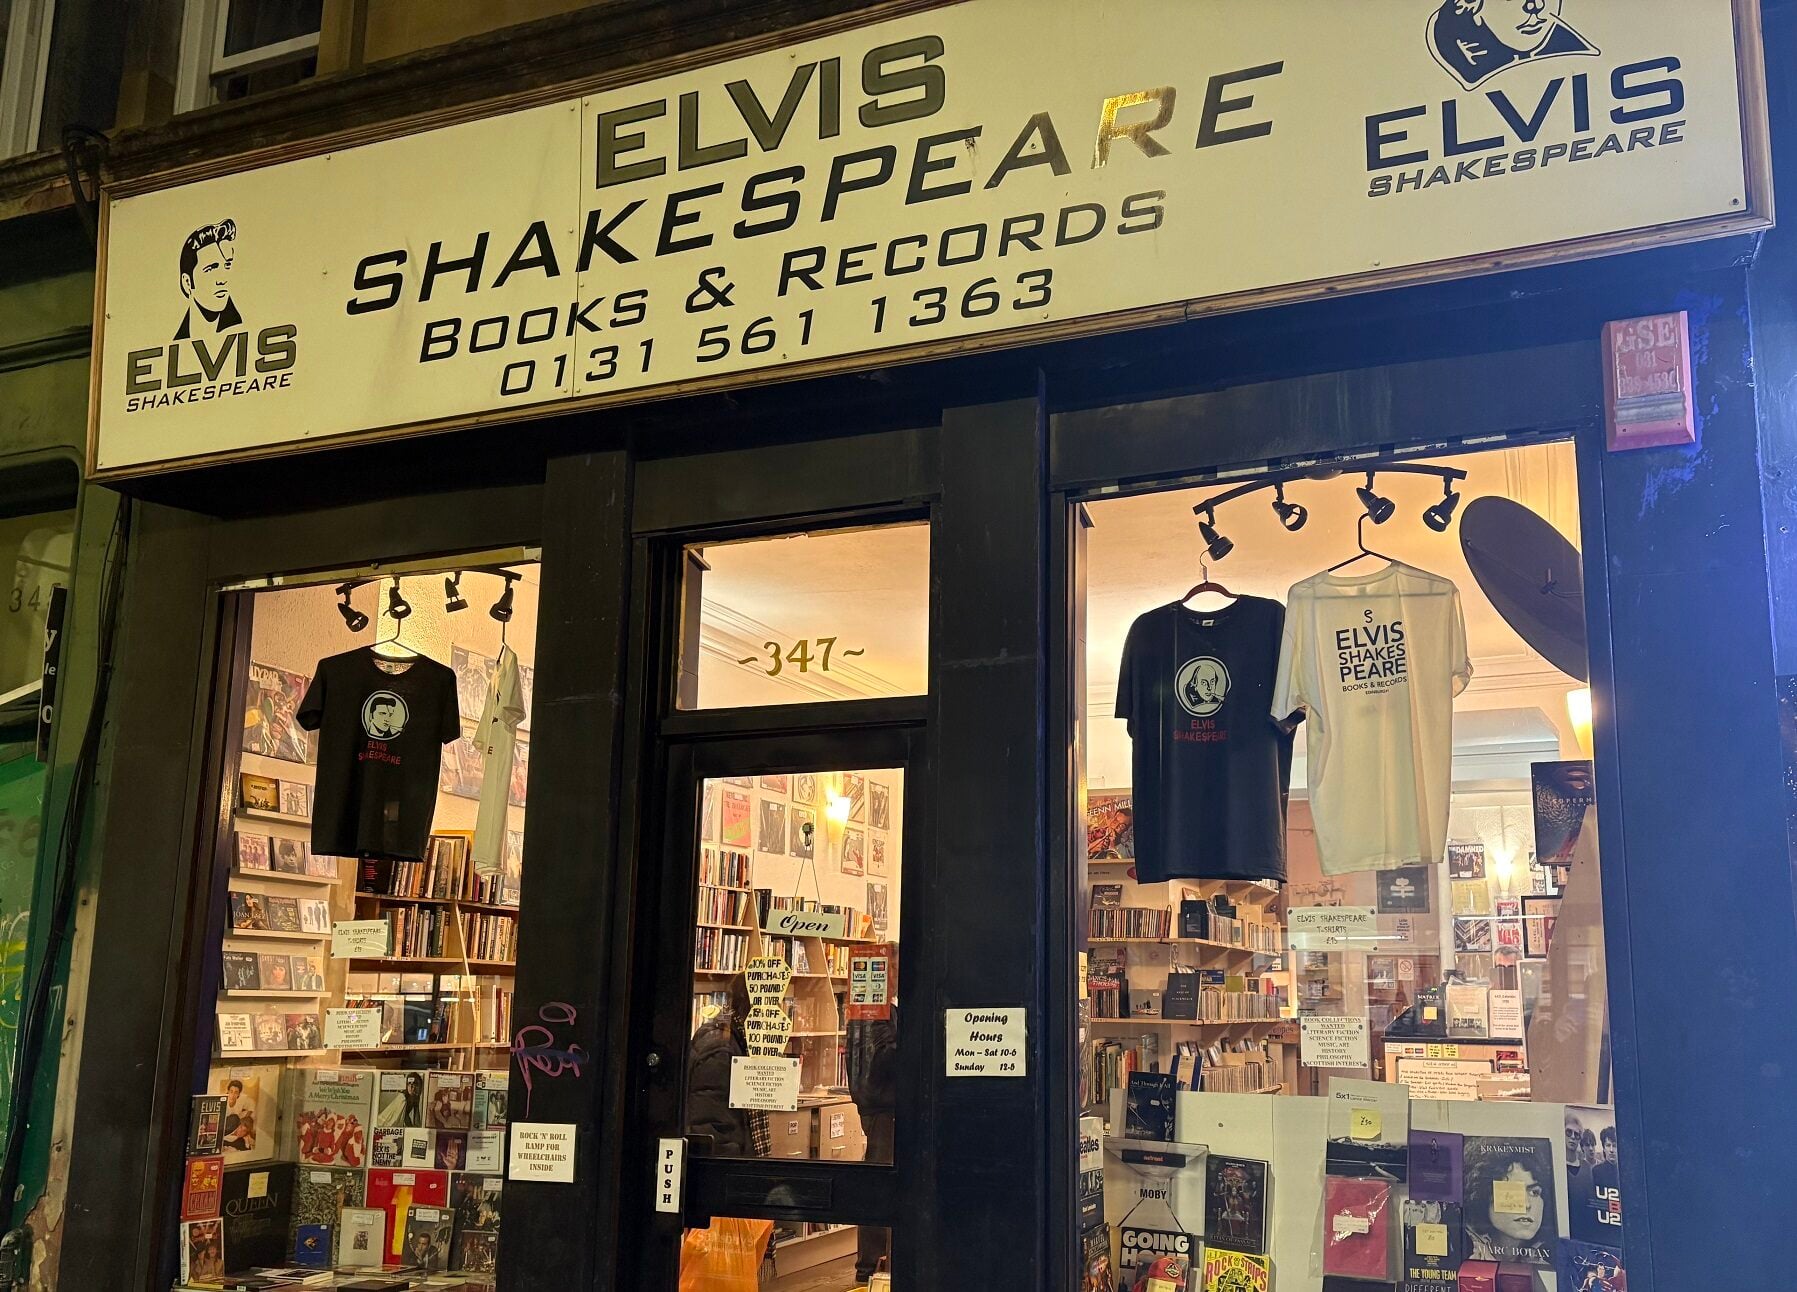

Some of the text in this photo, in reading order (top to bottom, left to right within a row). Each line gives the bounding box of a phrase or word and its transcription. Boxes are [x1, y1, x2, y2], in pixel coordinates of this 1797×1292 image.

[596, 34, 946, 189] ELVIS
[1365, 56, 1685, 172] ELVIS
[1367, 120, 1686, 198] SHAKESPEARE
[346, 61, 1284, 315] SHAKESPEARE
[419, 189, 1167, 363] BOOKS & RECORDS
[500, 268, 1054, 396] 0131 561 1363
[125, 324, 297, 395] ELVIS
[126, 372, 294, 413] SHAKESPEARE
[1336, 621, 1405, 650] ELVIS
[1339, 643, 1406, 666] SHAKES
[1340, 657, 1407, 683] PEARE
[1342, 682, 1369, 692] BOOKS
[1377, 676, 1408, 688] RECORDS
[1191, 719, 1216, 729] ELVIS
[1173, 730, 1227, 742] SHAKESPEARE
[367, 740, 388, 751] ELVIS
[233, 911, 250, 919] JOAN
[1296, 914, 1367, 923] ELVIS SHAKESPEARE
[779, 914, 830, 933] Open
[1316, 925, 1347, 934] T-SHIRTS
[767, 959, 781, 968] OFF
[747, 971, 790, 981] PURCHASES
[749, 984, 785, 993] 50 POUNDS
[753, 996, 779, 1006] OR OVER
[765, 1009, 780, 1018] OFF
[964, 1012, 1008, 1025] Opening
[746, 1021, 790, 1031] PURCHASES
[748, 1033, 788, 1044] 100 POUNDS
[969, 1031, 1003, 1043] Hours
[752, 1046, 778, 1057] OR OVER
[954, 1048, 975, 1057] Mon
[984, 1048, 998, 1057] Sat
[1000, 1048, 1017, 1057] 10-6
[954, 1062, 985, 1072] Sunday
[1336, 1092, 1350, 1100] 5x1
[201, 1102, 221, 1113] ELVIS
[374, 1127, 403, 1136] GARBAGE
[519, 1132, 538, 1140] ROCK
[549, 1133, 567, 1141] ROLL
[525, 1142, 560, 1151] RAMP FOR
[517, 1152, 567, 1162] WHEELCHAIRS
[529, 1163, 554, 1172] INSIDE
[662, 1149, 674, 1204] PUSH
[1139, 1188, 1168, 1200] MOBY
[1596, 1185, 1620, 1202] U2
[226, 1193, 278, 1217] QUEEN
[1597, 1209, 1622, 1227] U2
[1123, 1231, 1190, 1253] GOING
[1478, 1245, 1550, 1258] MARC BOLAN
[1206, 1255, 1234, 1284] ROCK
[1240, 1257, 1267, 1292] STRIPS
[1409, 1268, 1457, 1281] THE YOUNG TEAM
[1405, 1283, 1451, 1292] DIFFERENT
